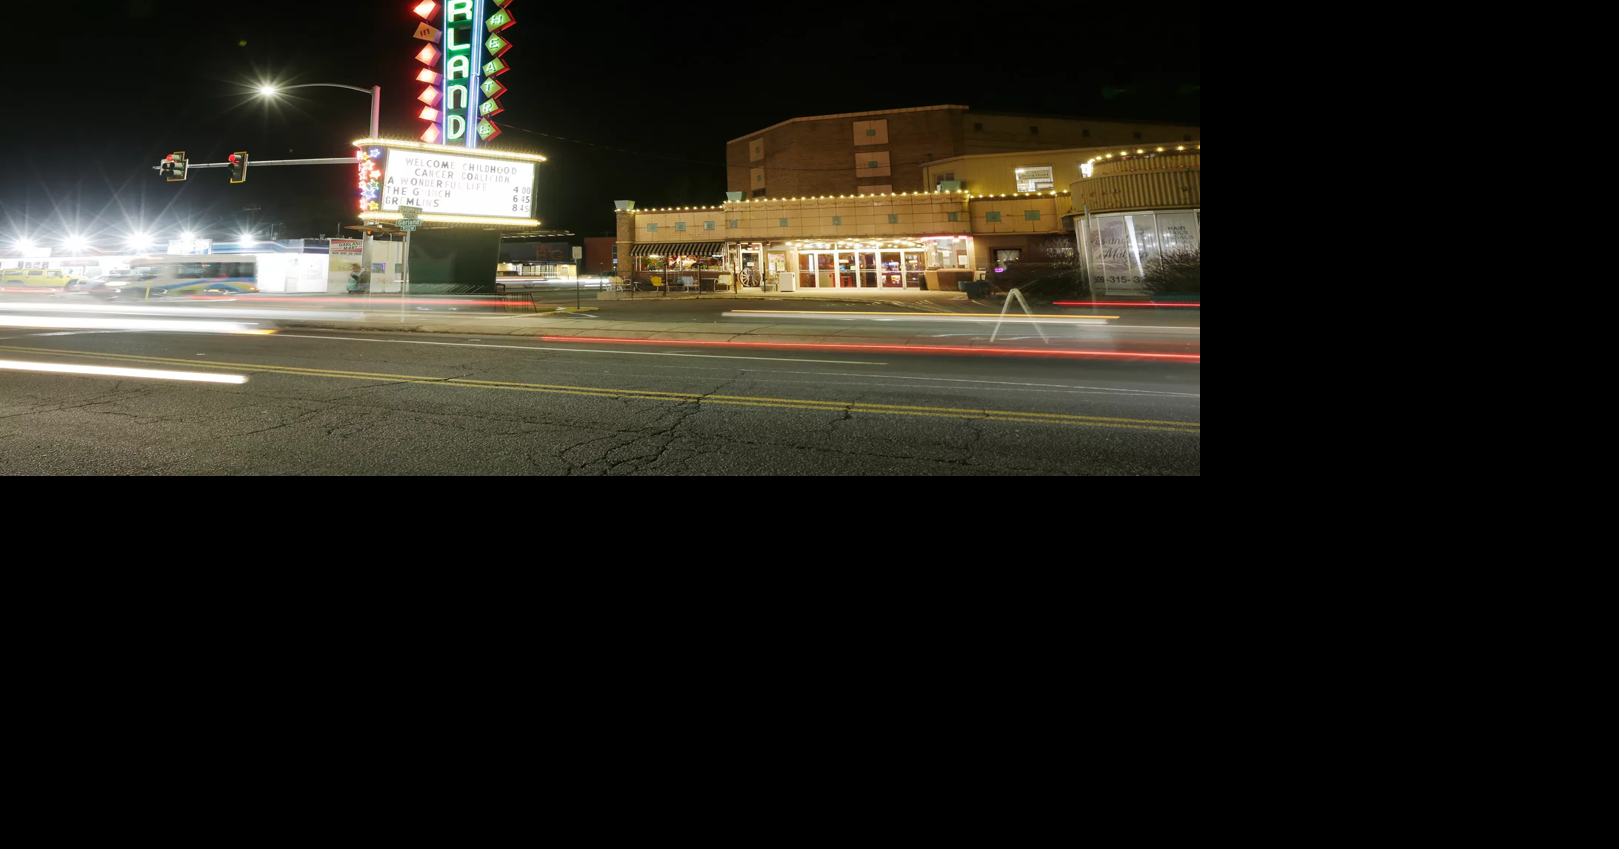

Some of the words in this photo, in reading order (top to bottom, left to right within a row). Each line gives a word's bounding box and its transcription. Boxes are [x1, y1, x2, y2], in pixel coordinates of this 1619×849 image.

[405, 157, 455, 170] WELCOME
[462, 162, 517, 175] CHILDHOOD
[414, 168, 454, 179] CANCER
[461, 172, 510, 184] COALITION
[387, 176, 394, 184] A
[400, 177, 463, 190] WONDERFUL
[466, 182, 487, 191] LIFE
[387, 185, 407, 196] THE
[412, 187, 451, 198] GINCH
[385, 195, 440, 208] GREMLINS
[398, 219, 420, 227] Garland
[536, 249, 564, 261] BG
